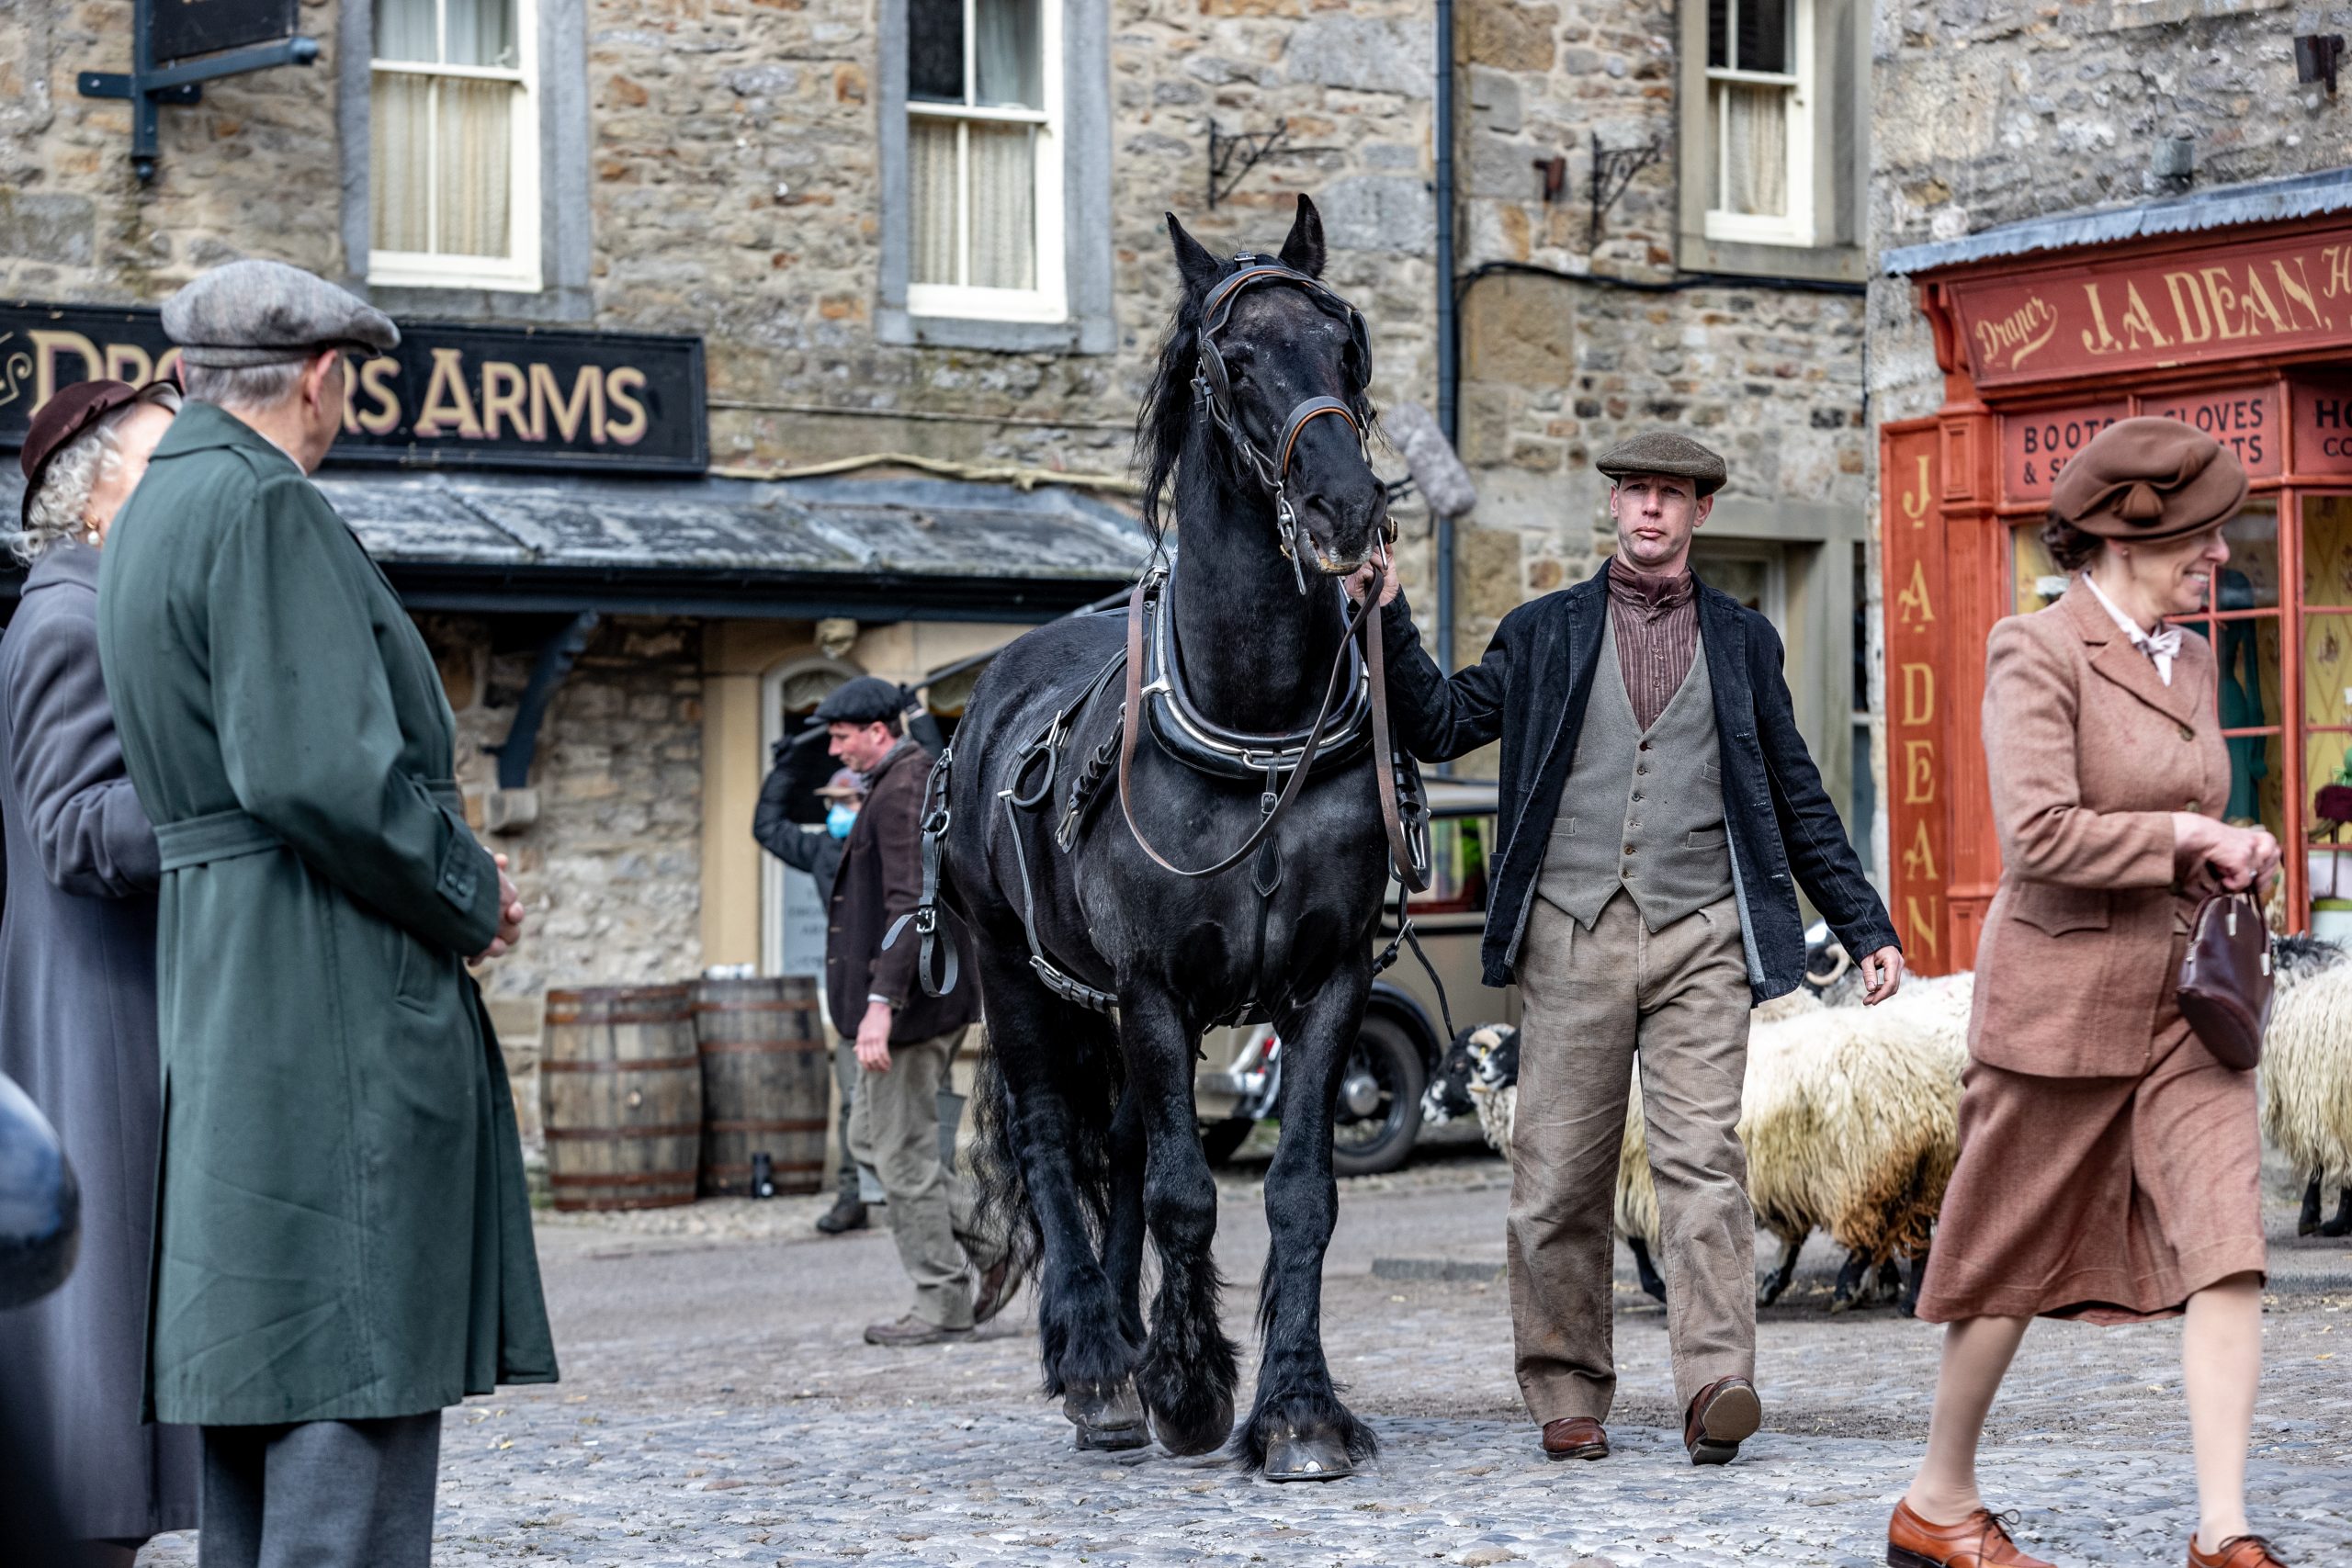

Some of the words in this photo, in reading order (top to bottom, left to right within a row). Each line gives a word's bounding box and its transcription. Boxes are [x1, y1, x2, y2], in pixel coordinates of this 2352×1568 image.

[1975, 296, 2052, 364] Draper
[413, 348, 648, 446] ARMS
[1901, 662, 1939, 959] DEAN
